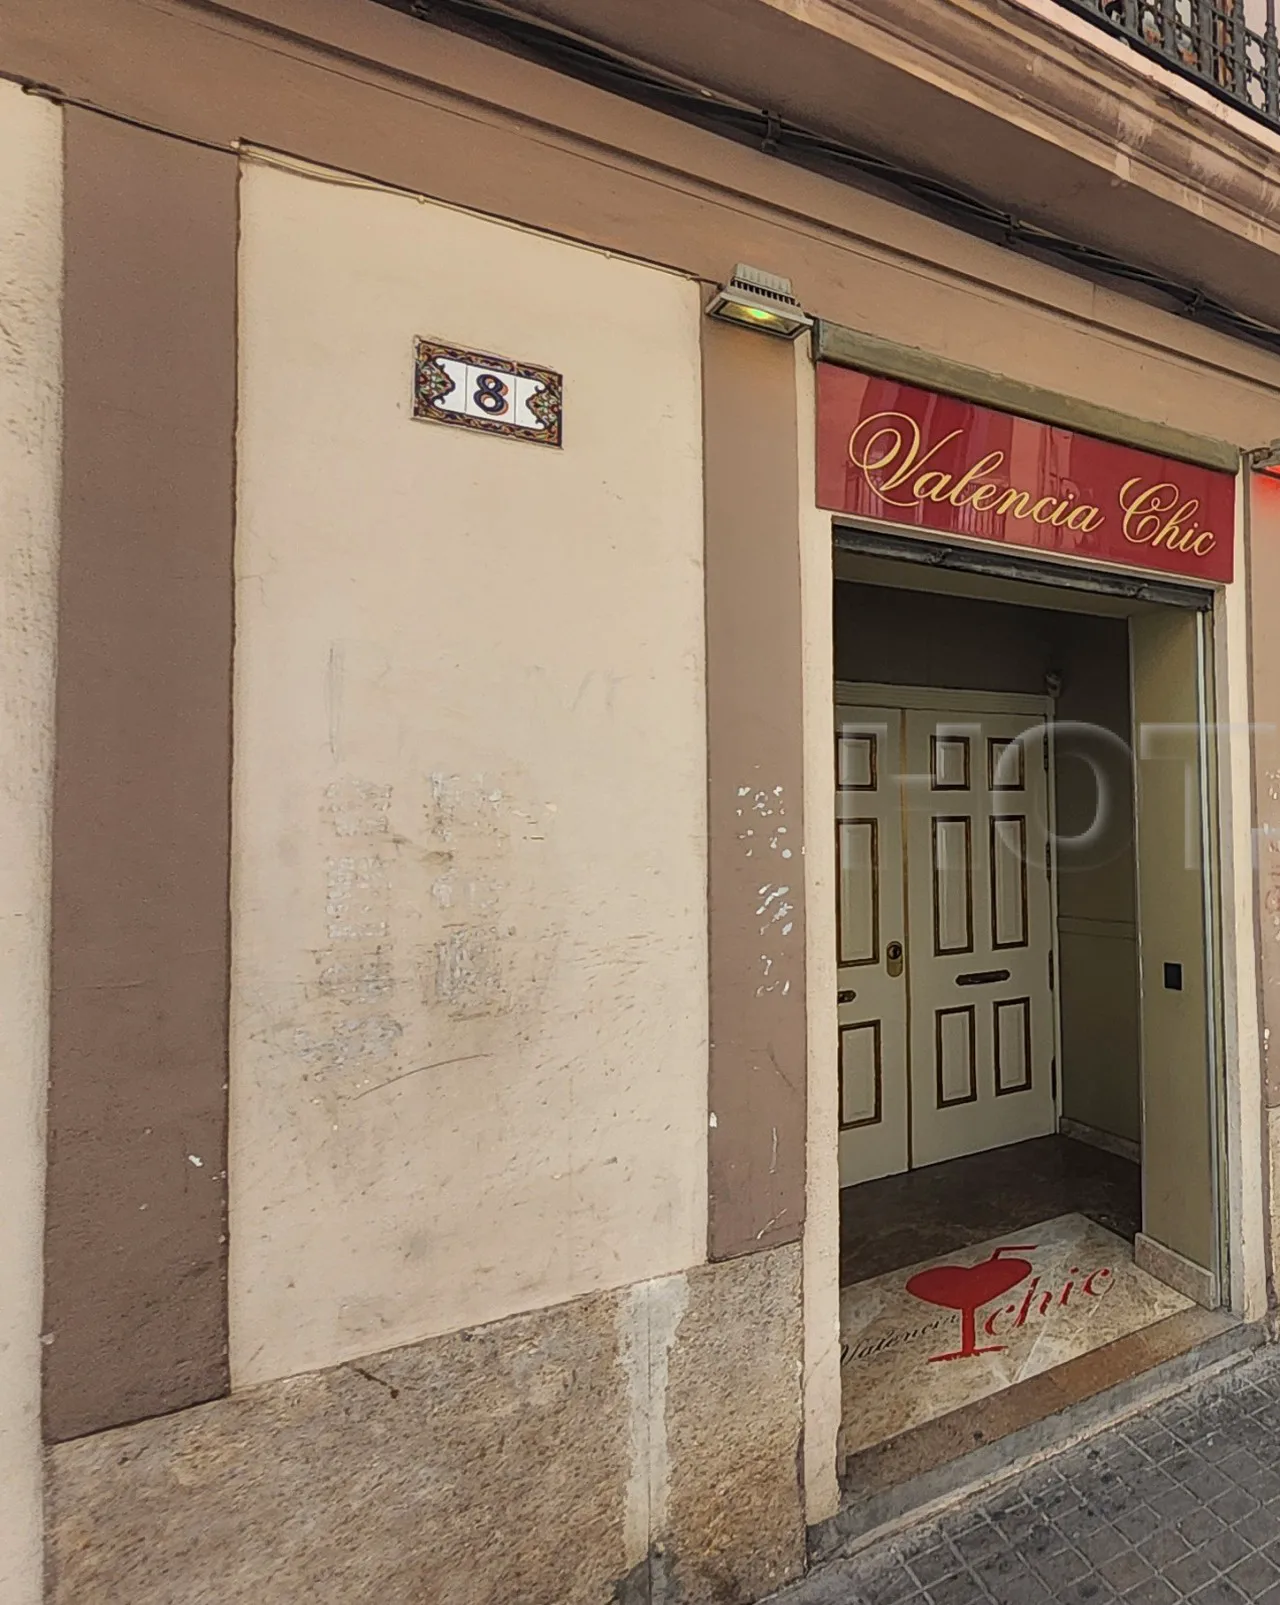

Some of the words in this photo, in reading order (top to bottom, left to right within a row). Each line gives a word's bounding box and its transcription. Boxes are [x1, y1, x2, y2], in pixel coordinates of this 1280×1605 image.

[473, 373, 509, 416] 8
[848, 411, 1106, 533] Valencia
[1119, 476, 1217, 557] Chic
[984, 1266, 1115, 1336] chic
